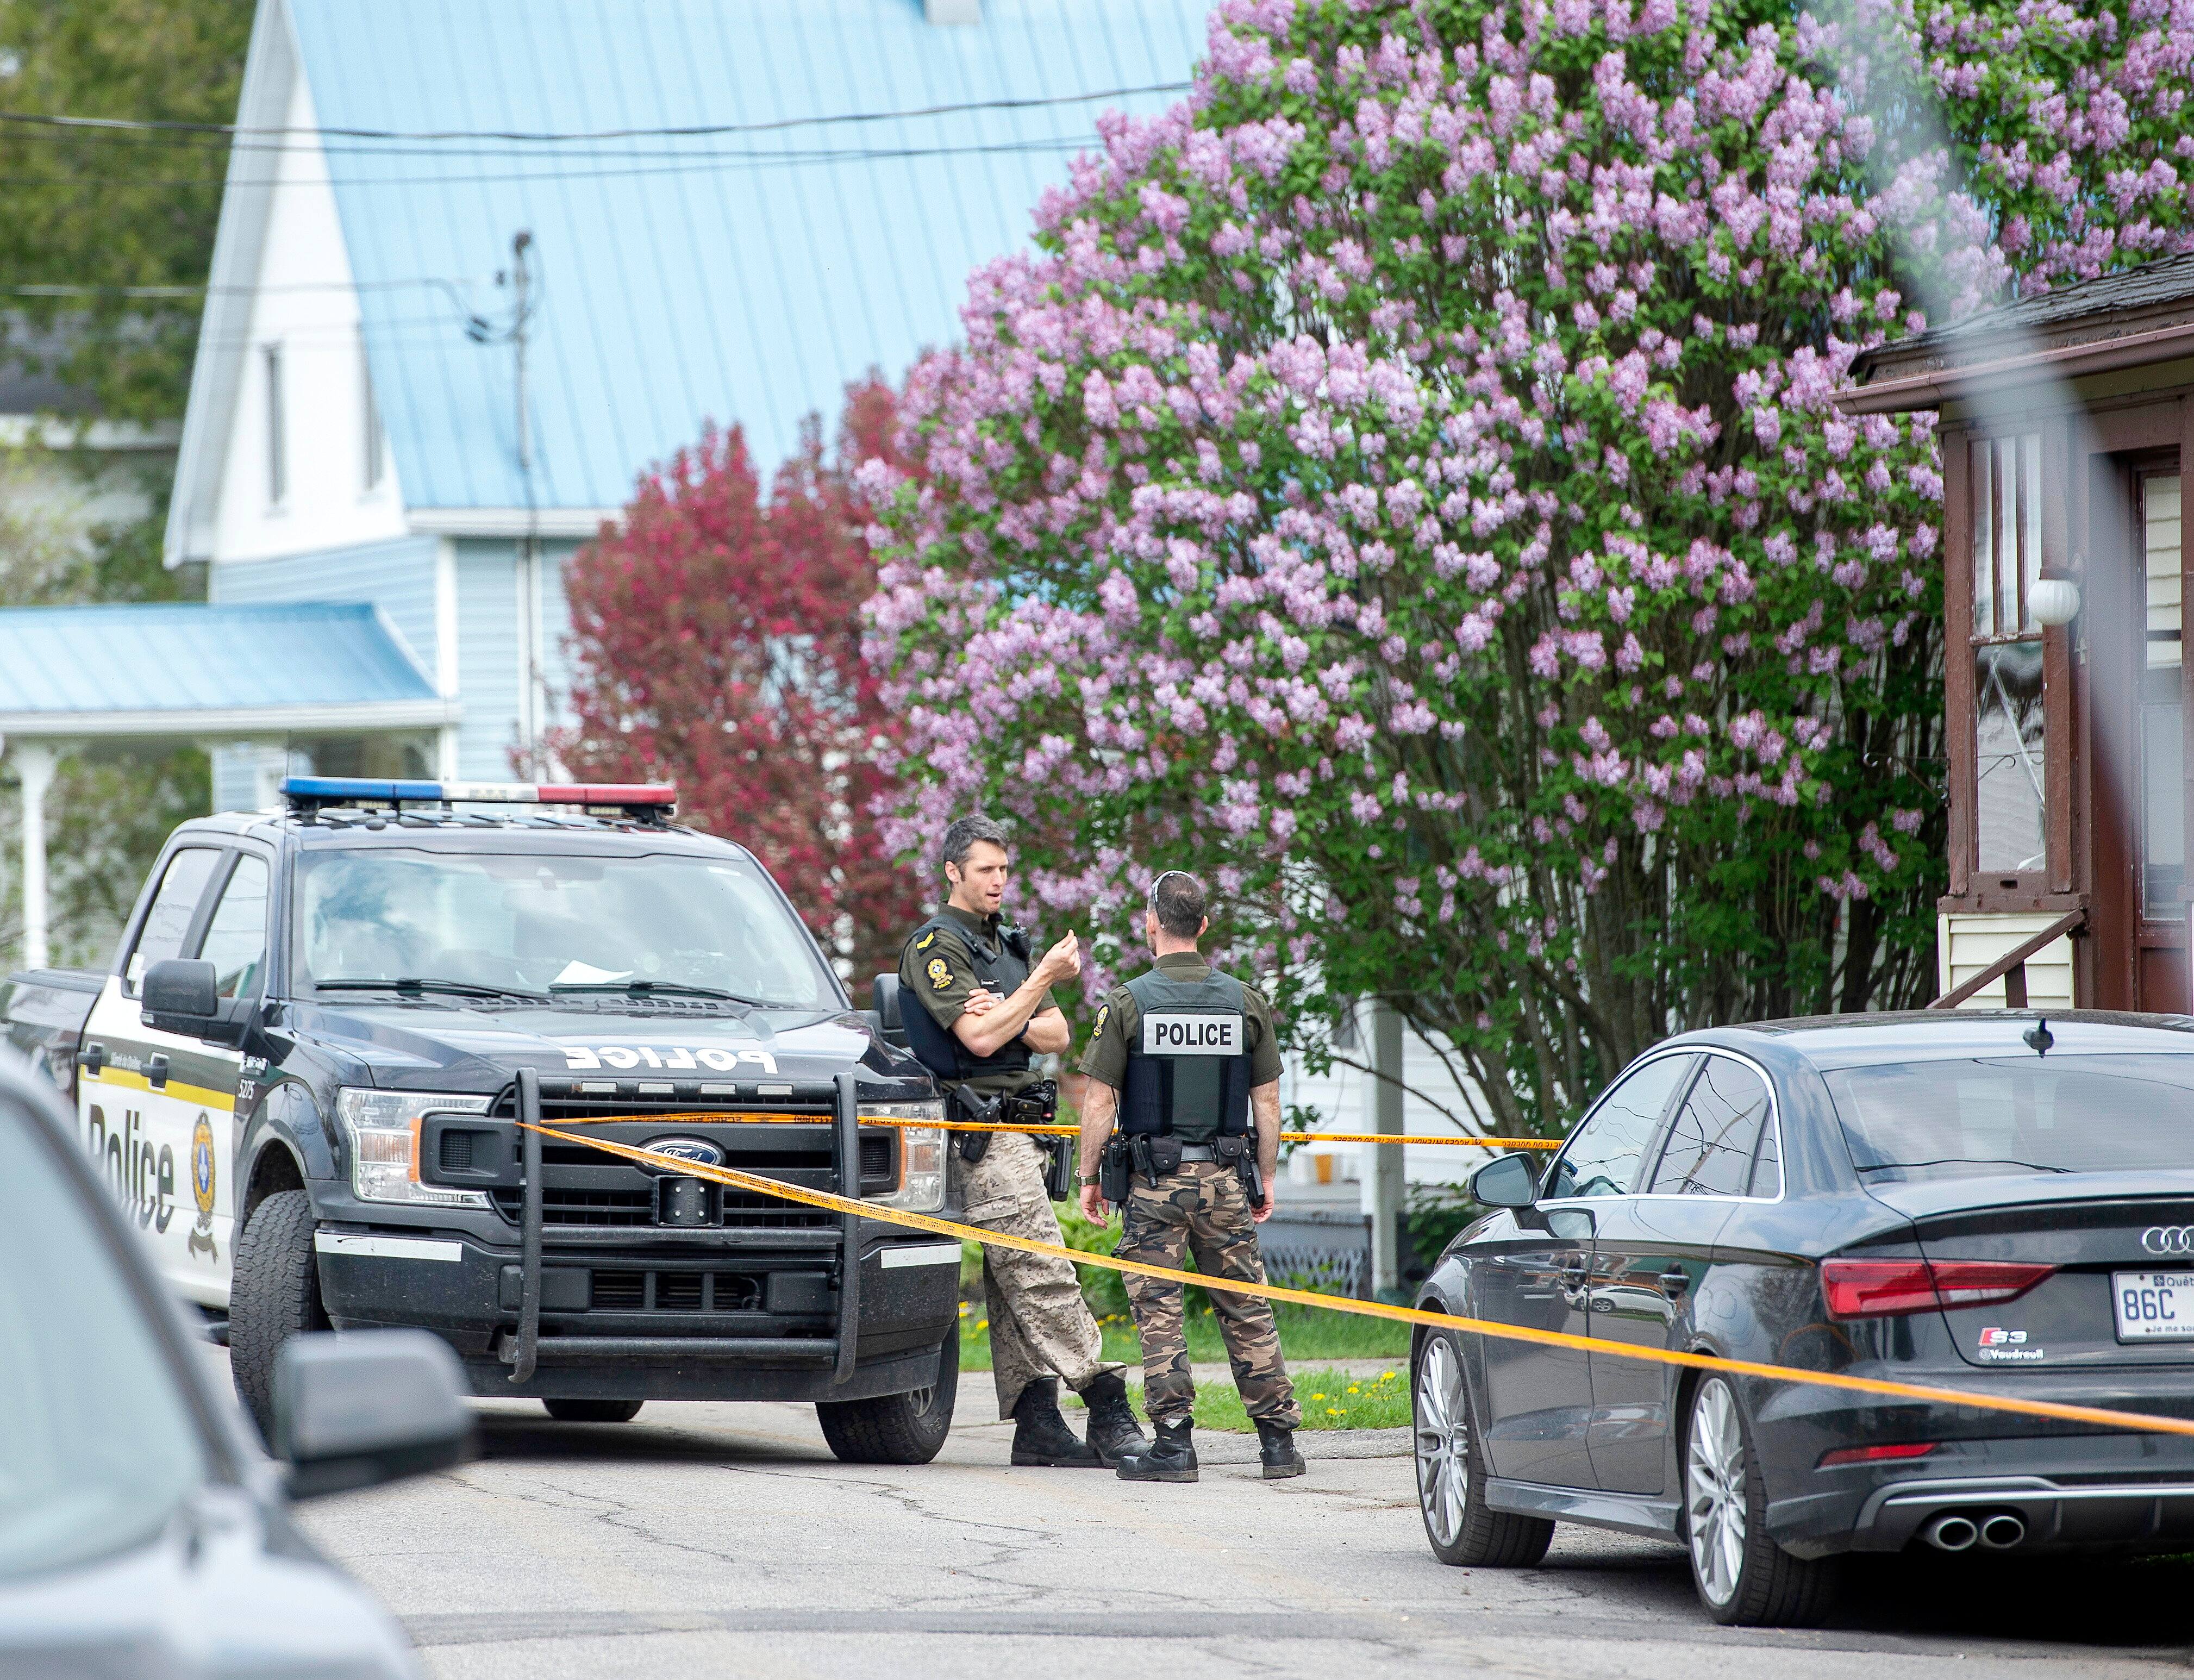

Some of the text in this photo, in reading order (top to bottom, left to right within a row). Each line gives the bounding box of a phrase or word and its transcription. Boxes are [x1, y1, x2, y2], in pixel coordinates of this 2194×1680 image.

[1155, 1023, 1232, 1046] POLICE
[89, 1103, 174, 1234] Police
[2123, 1289, 2175, 1320] 86C
[1990, 1331, 2028, 1344] S3
[1990, 1348, 2043, 1359] Vaudreuil
